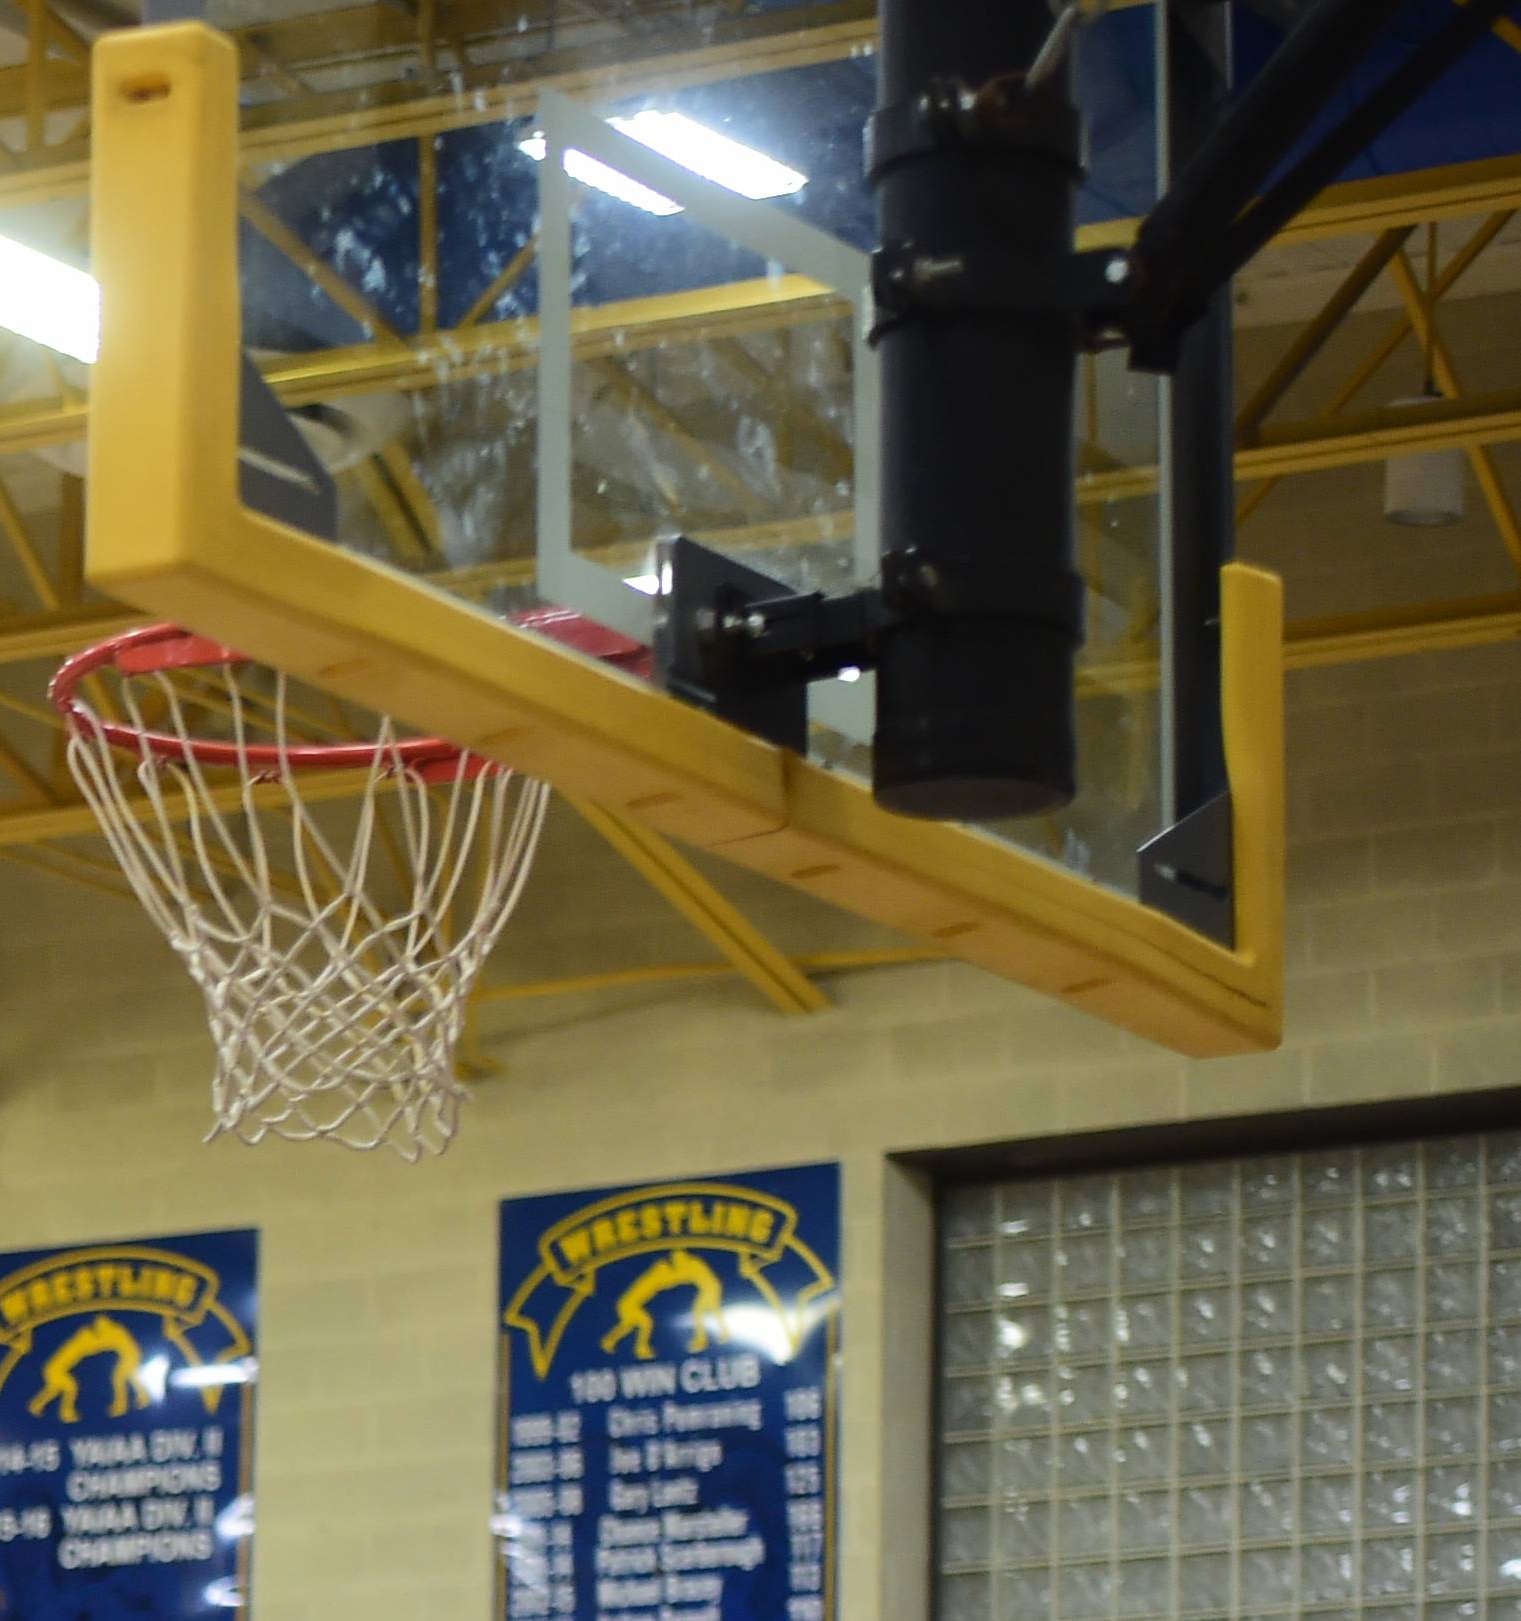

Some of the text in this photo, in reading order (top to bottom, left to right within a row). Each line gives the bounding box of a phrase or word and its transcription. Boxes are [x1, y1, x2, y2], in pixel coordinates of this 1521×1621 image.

[559, 1202, 773, 1259] WRESTLING
[570, 1352, 760, 1404] 100 WIN CLUB
[66, 1460, 222, 1502] CHAMPIONS
[59, 1528, 213, 1570] CHAMPIONS
